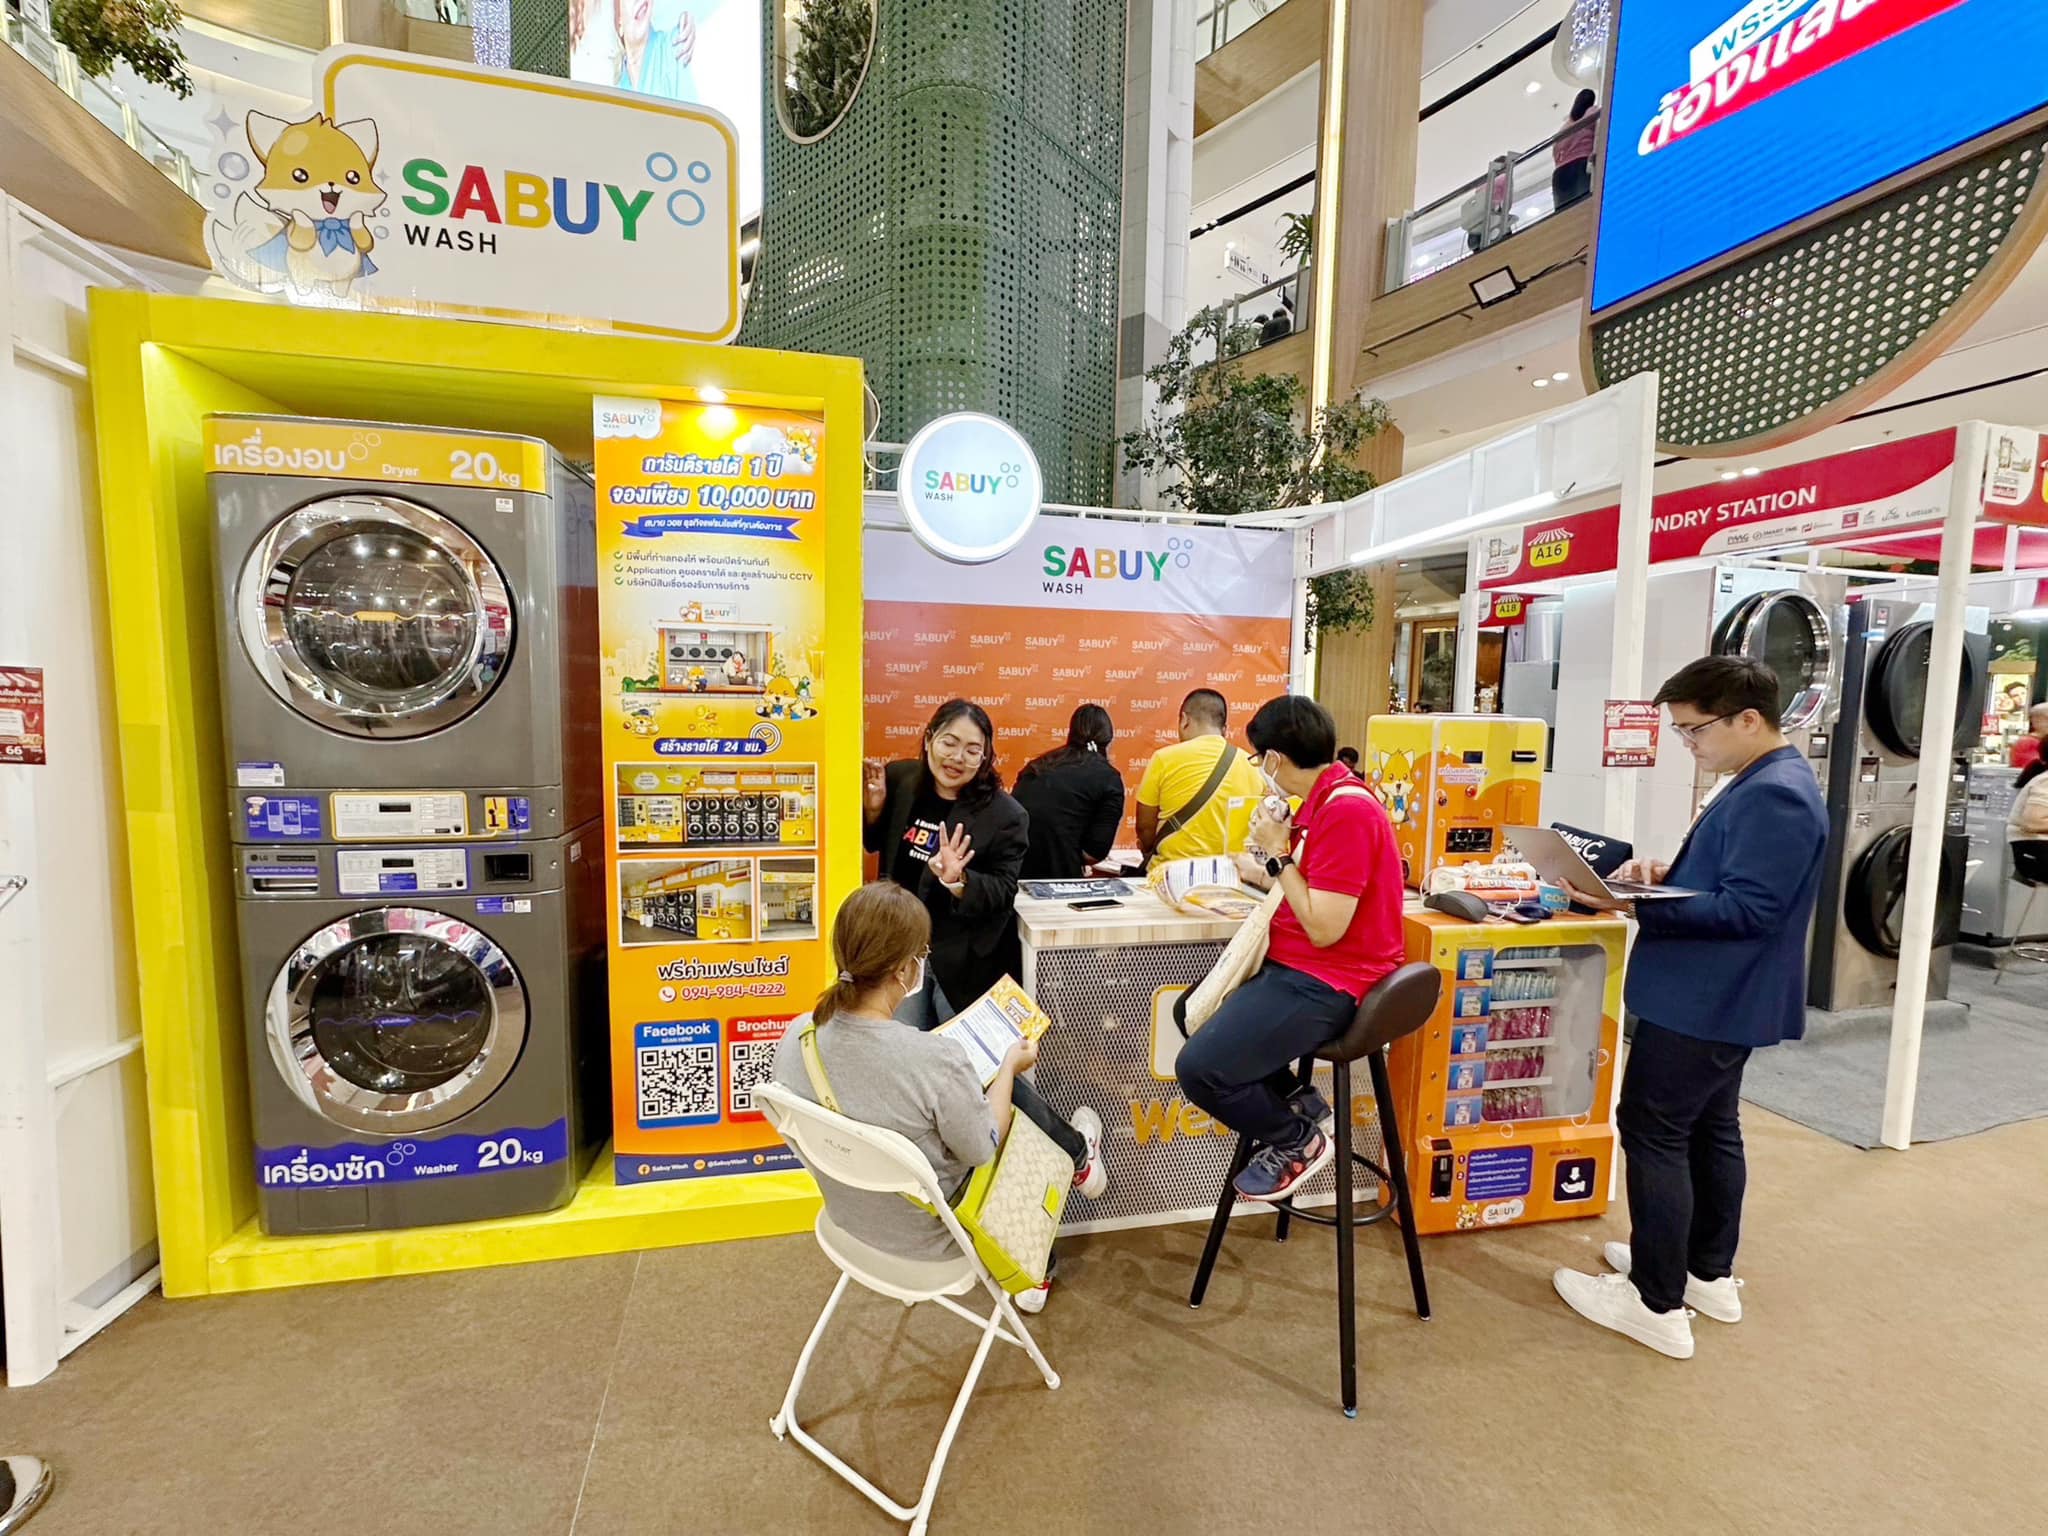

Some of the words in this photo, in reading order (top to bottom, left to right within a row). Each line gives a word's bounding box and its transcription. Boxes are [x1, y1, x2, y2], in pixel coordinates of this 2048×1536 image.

[401, 158, 654, 241] SABUY
[404, 223, 497, 254] WASH
[602, 412, 645, 426] SABUY
[214, 427, 346, 471] เครื่องอบ
[382, 464, 419, 477] Dryer
[643, 453, 741, 476] การันตีรายได้
[751, 458, 761, 476] 1
[767, 453, 783, 476] ปี
[925, 470, 1001, 495] SABUY
[611, 482, 689, 505] จองเพียง
[699, 486, 770, 510] 10,000
[773, 490, 815, 510] บาท
[925, 491, 953, 502] WASH
[1716, 485, 1816, 521] STATION
[1535, 544, 1562, 560] A16
[1042, 545, 1170, 582] SABUY
[789, 572, 813, 581] CCTV
[1042, 582, 1083, 594] WASH
[1499, 604, 1517, 613] A18
[660, 739, 719, 753] สร้างรายได้
[724, 742, 738, 753] 24
[744, 742, 762, 753] ชม.
[658, 956, 789, 980] ฟรีค่าแฟรนไชส์
[682, 984, 785, 1000] 094-984-4222
[643, 1023, 711, 1038] Facebook
[264, 1149, 386, 1184] เครื่องซัก
[414, 1162, 460, 1176] Washer
